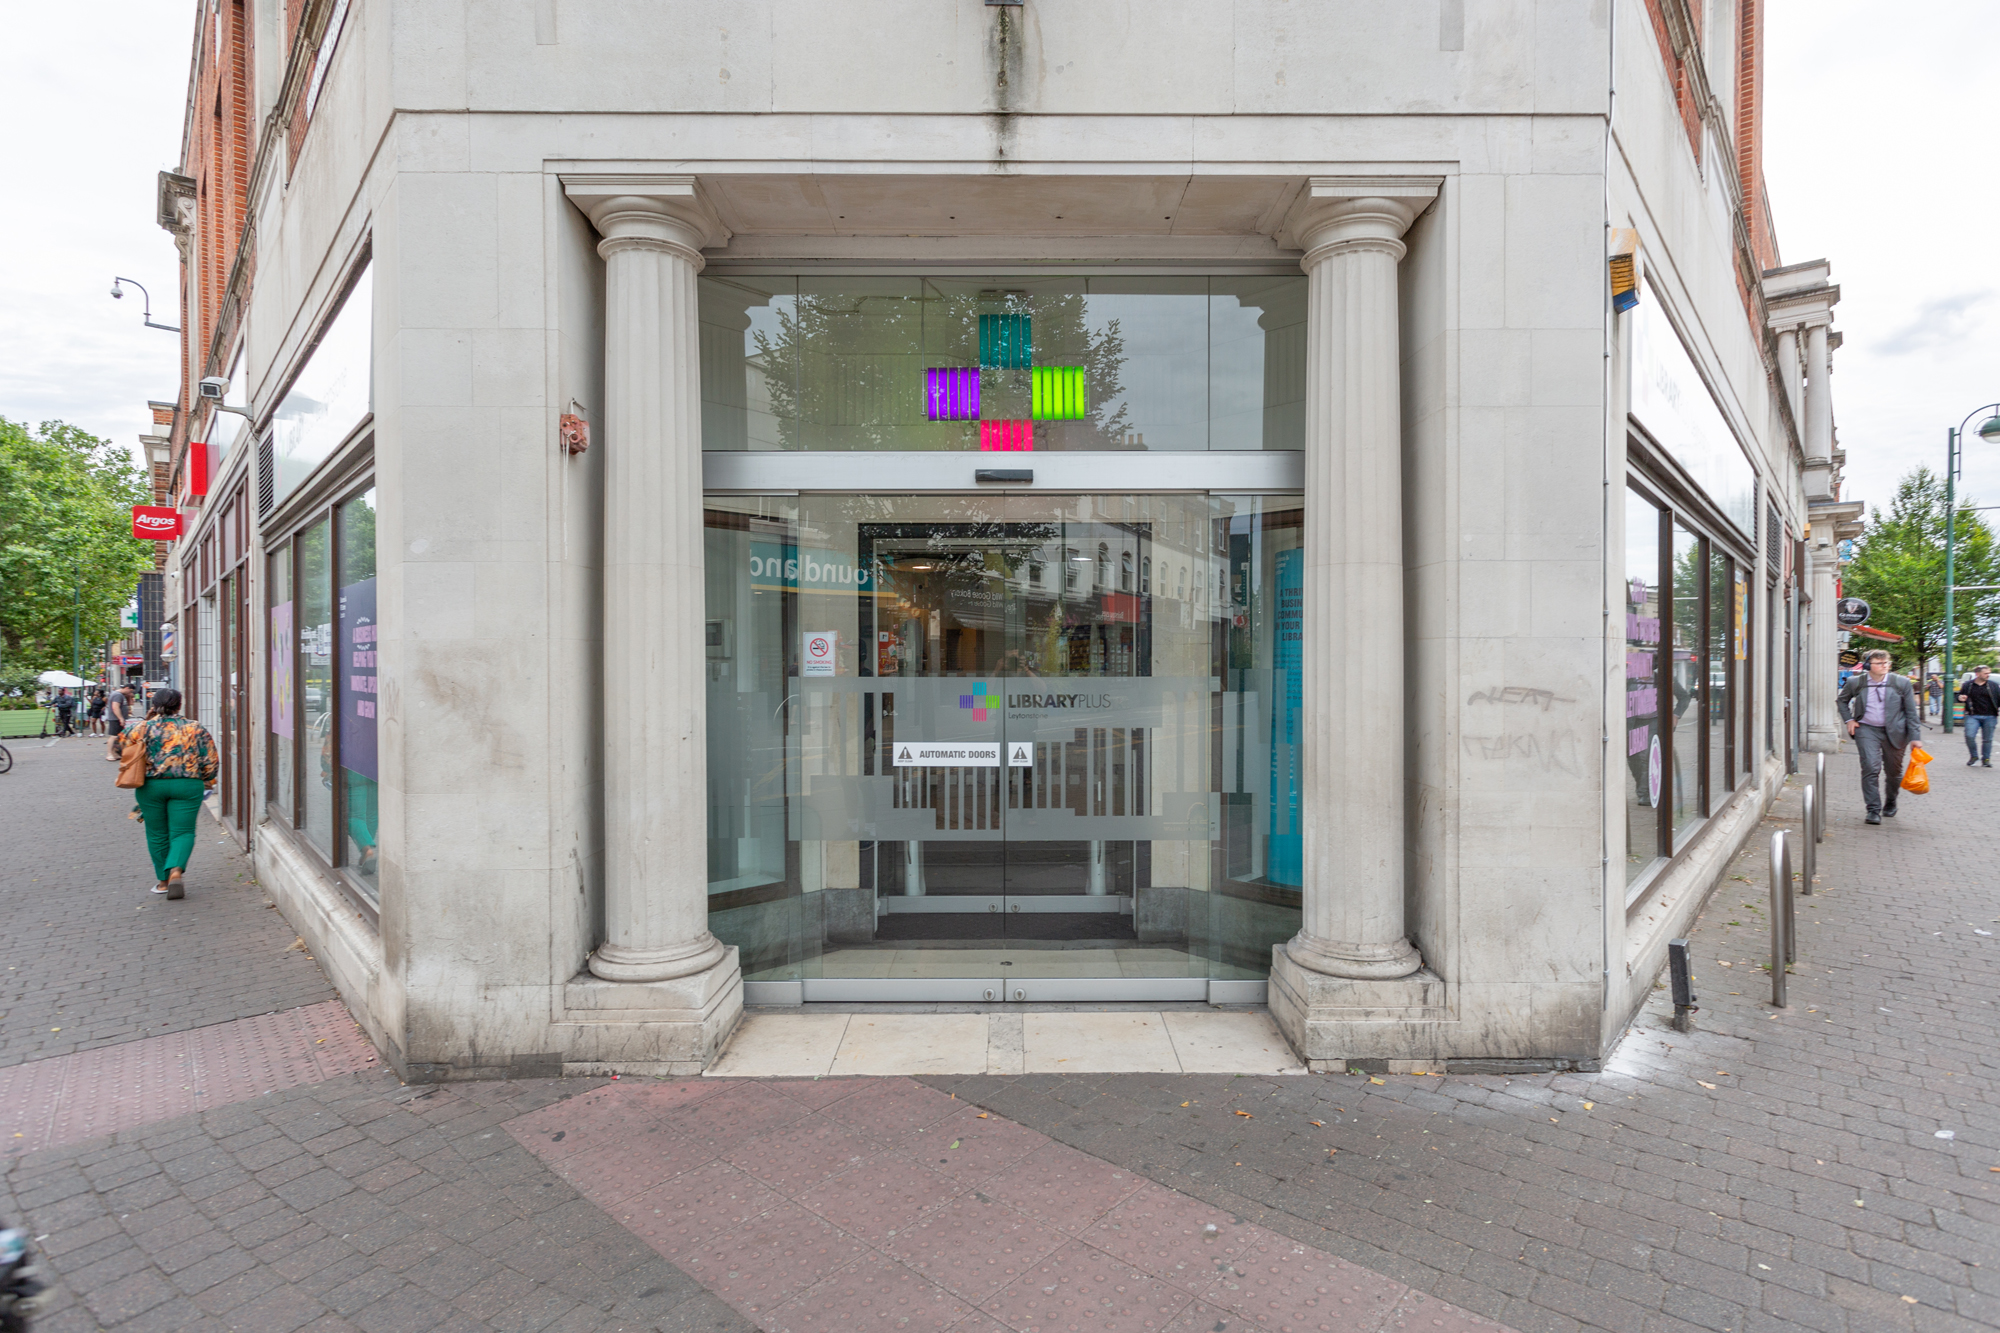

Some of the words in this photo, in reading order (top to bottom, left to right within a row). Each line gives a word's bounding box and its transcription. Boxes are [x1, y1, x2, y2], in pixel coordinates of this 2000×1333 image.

[135, 514, 176, 527] Argos
[1280, 589, 1284, 597] A
[1281, 621, 1301, 630] YOUR
[1008, 712, 1049, 720] Leytonstone
[919, 750, 966, 759] AUTOMATIC
[968, 750, 996, 759] DOORS
